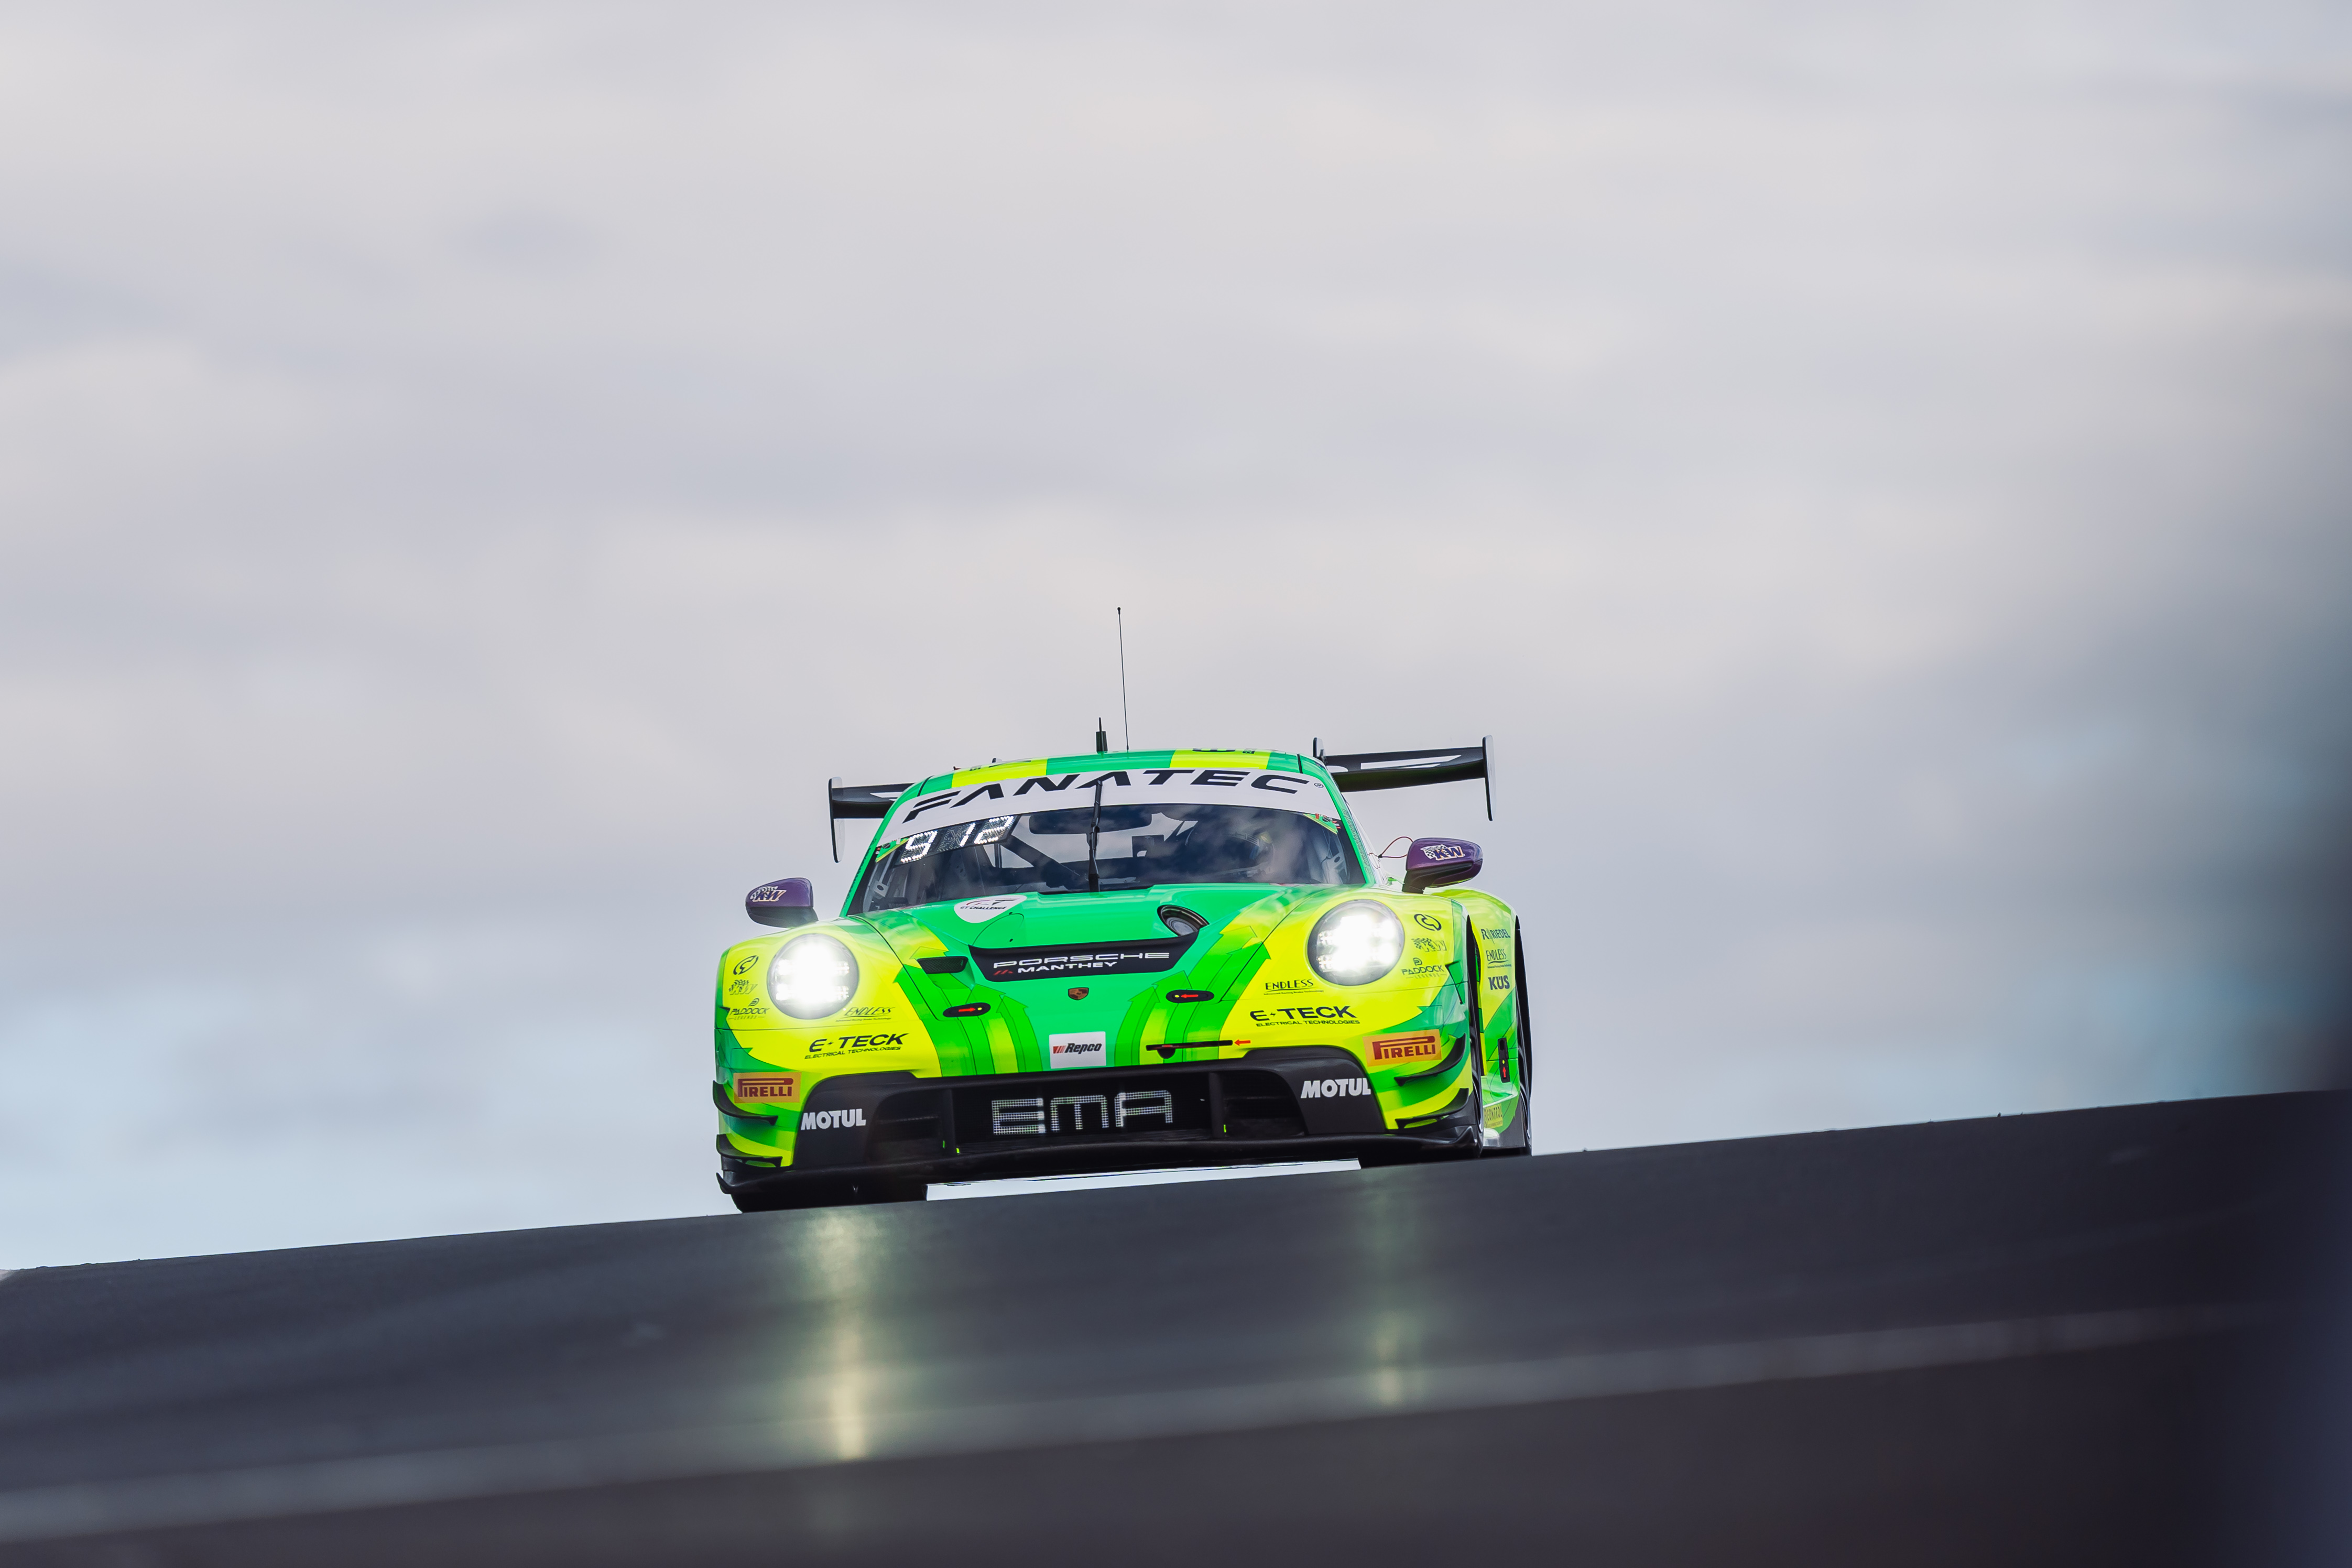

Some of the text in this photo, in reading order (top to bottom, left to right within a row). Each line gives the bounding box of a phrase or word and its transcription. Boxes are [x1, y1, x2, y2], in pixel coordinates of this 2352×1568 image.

[902, 769, 1310, 823] FANATEC
[994, 953, 1170, 968] PORSCHE
[1486, 949, 1507, 961] ENDLESS
[1018, 961, 1117, 973] MANTHEY
[1401, 965, 1444, 975] PADDOCK
[1265, 978, 1314, 990] ENDLESS
[1488, 975, 1510, 990] KÜS
[844, 1007, 896, 1016] ENDLESS
[1065, 1043, 1103, 1055] Repco
[1372, 1036, 1436, 1060] PIRELLI
[804, 1051, 845, 1060] ELECTRICAL
[737, 1078, 794, 1097] PIRELLI
[1300, 1078, 1371, 1099] MOTUL
[801, 1108, 866, 1130] MOTUL
